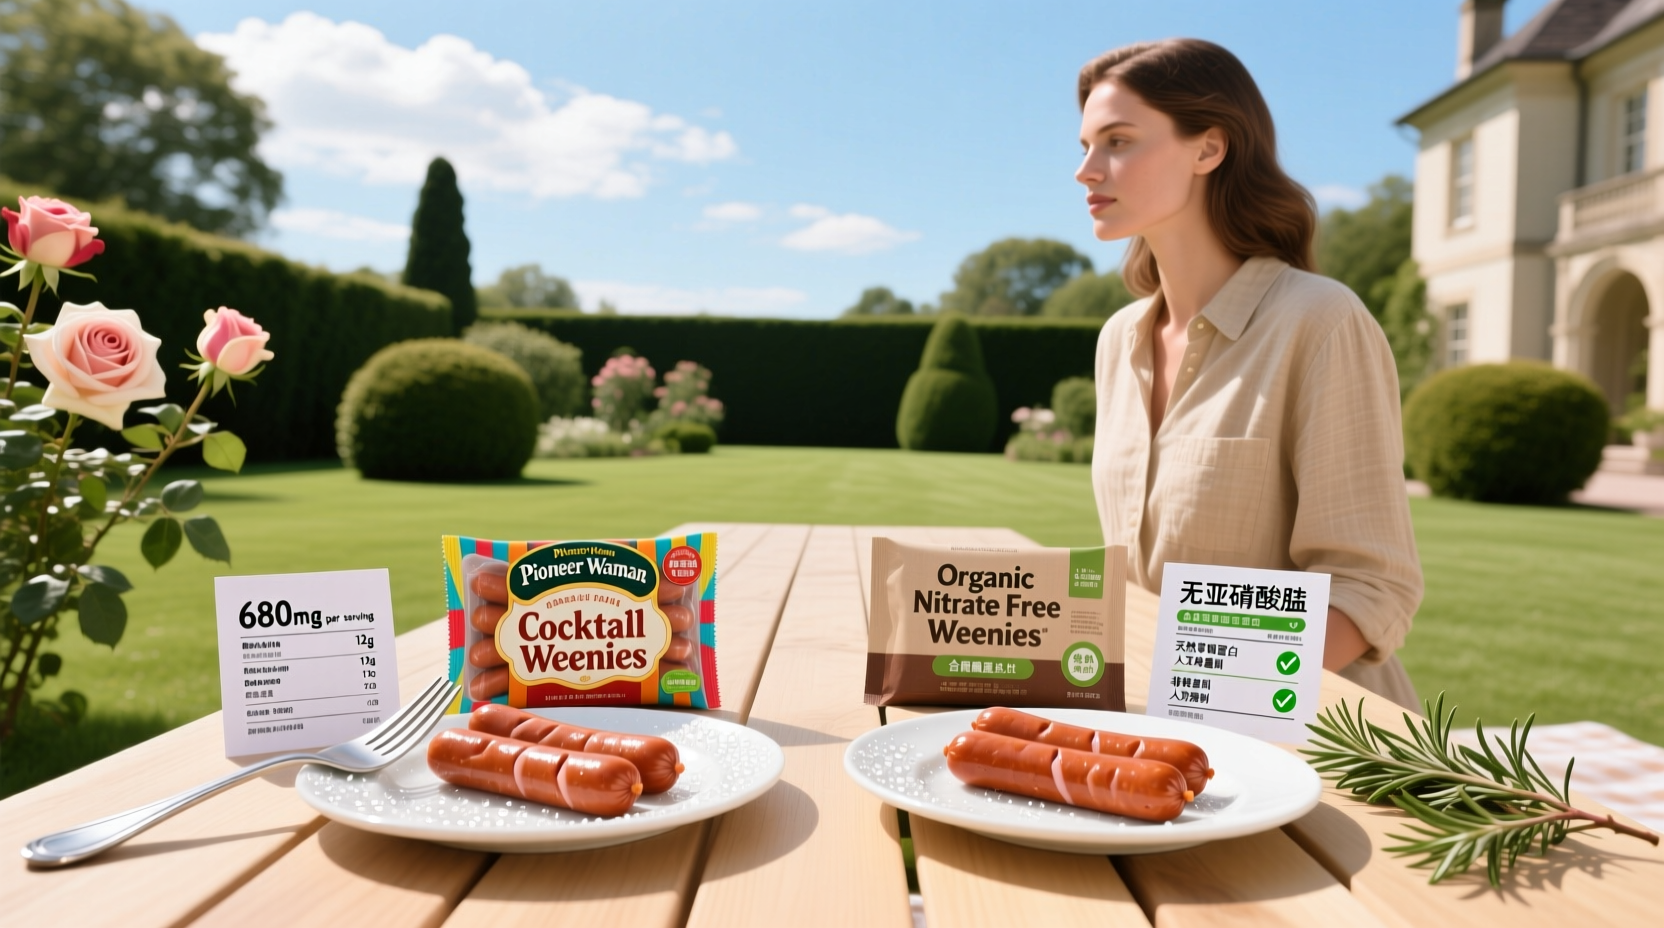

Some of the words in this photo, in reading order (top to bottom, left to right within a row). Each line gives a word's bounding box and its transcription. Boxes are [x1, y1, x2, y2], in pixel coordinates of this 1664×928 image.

[519, 563, 584, 586] Pioneer
[937, 563, 1034, 593] Organic
[239, 600, 322, 629] 680mg
[913, 590, 1000, 616] Nitrate
[1006, 594, 1061, 618] Free
[355, 634, 374, 649] 12g
[928, 619, 1042, 648] Weenies
[519, 641, 647, 673] Weenies
